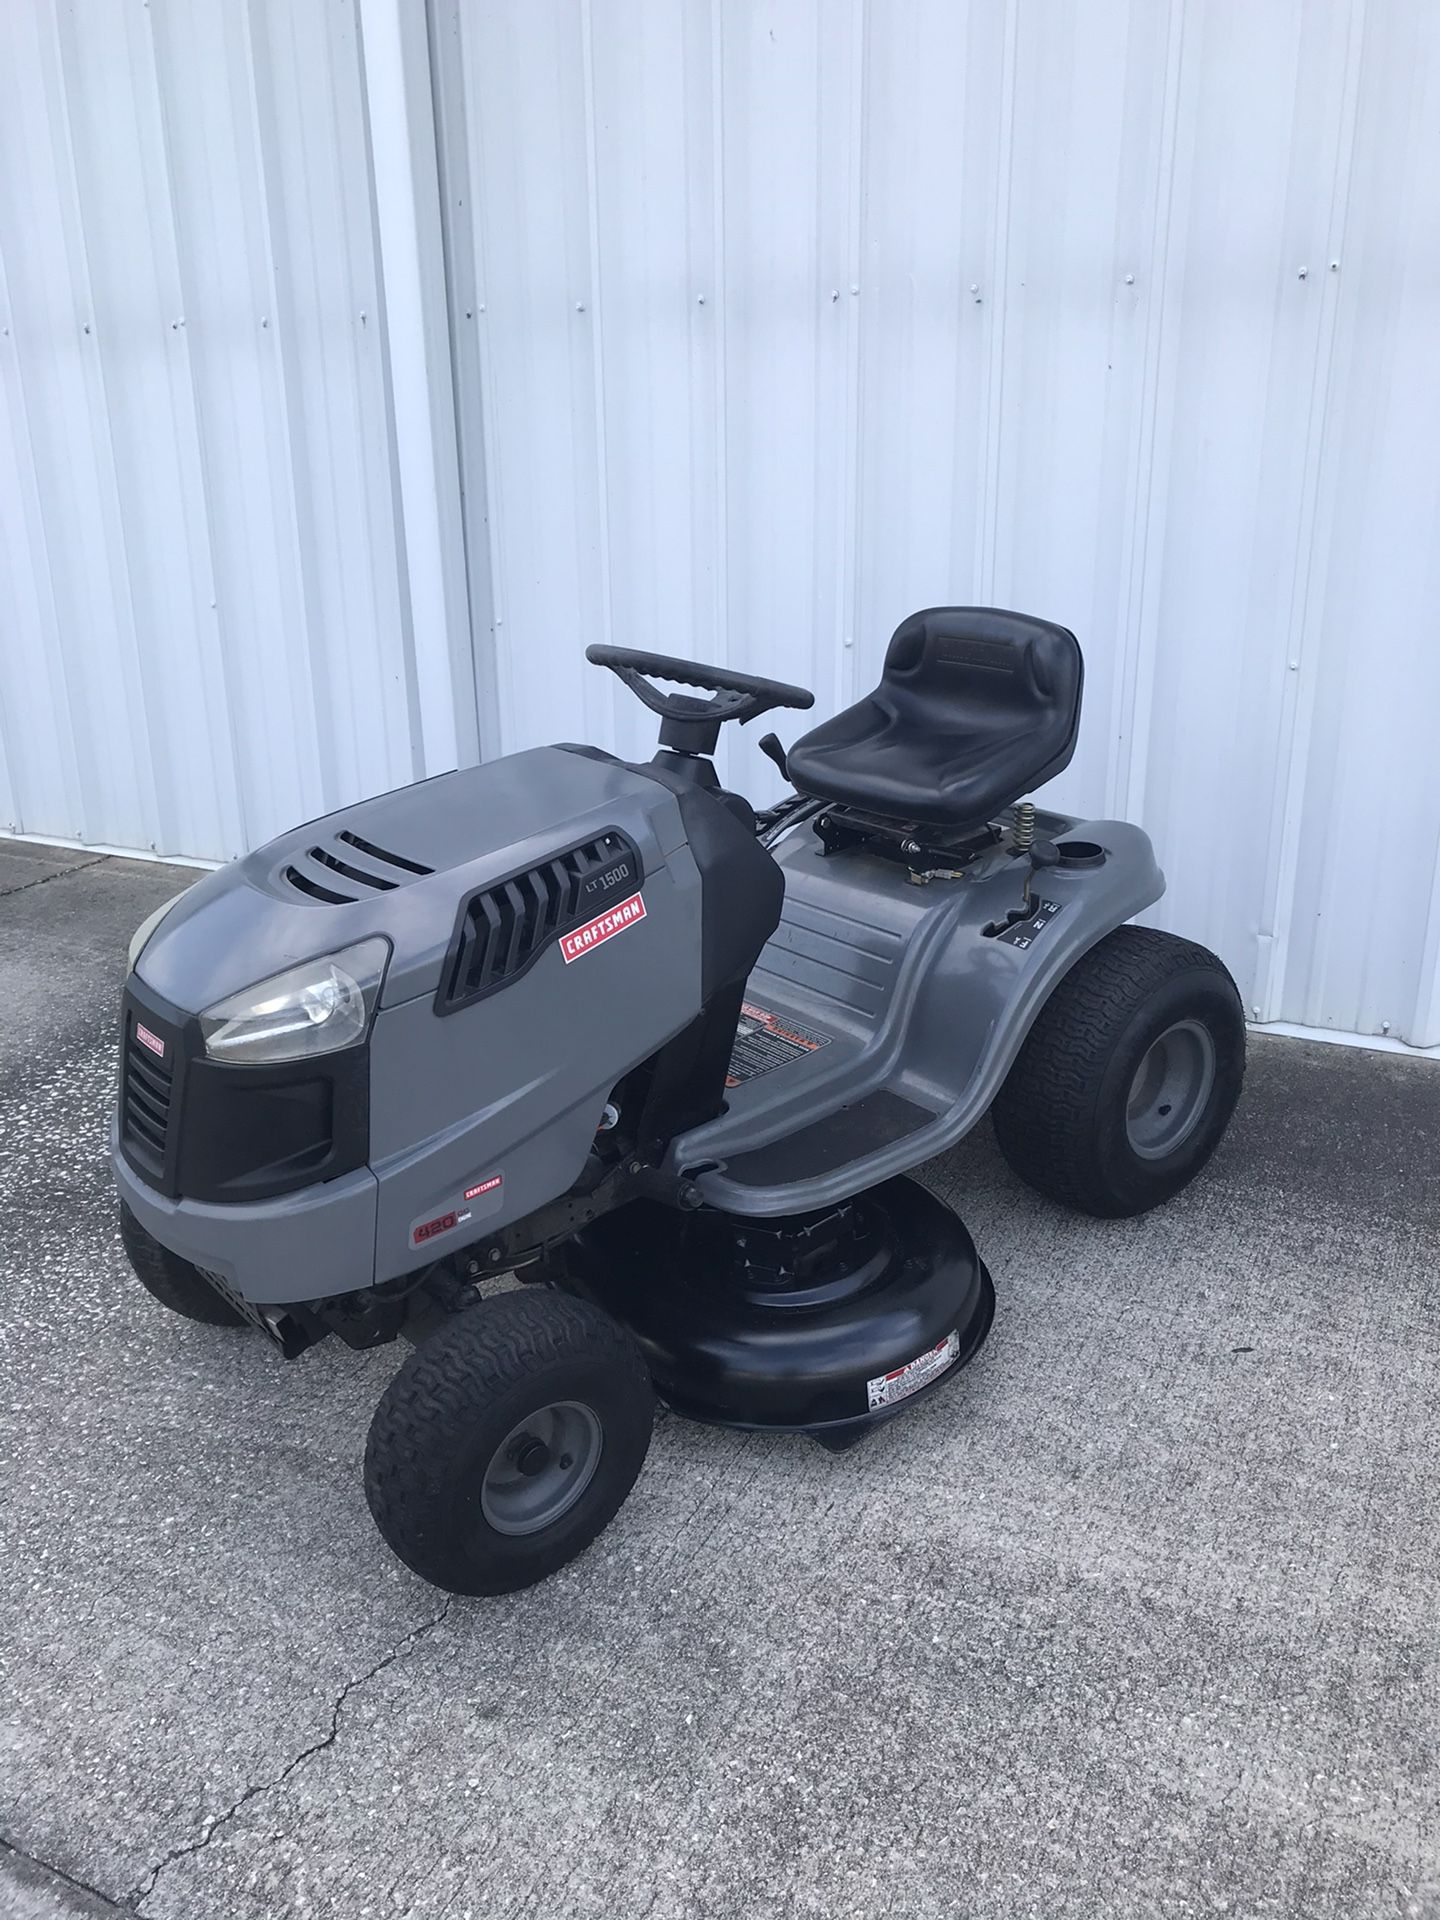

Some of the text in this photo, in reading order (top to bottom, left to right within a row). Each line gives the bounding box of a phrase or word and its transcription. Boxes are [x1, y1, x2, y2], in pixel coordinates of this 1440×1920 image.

[585, 863, 630, 893] LT 1500
[1047, 904, 1058, 913] R
[566, 900, 641, 954] CRAFTSMAN
[1033, 920, 1044, 930] N
[1019, 940, 1029, 949] F
[465, 1177, 501, 1199] CRAFTSMAN
[418, 1215, 455, 1237] 420
[911, 1347, 938, 1369] DANGER
